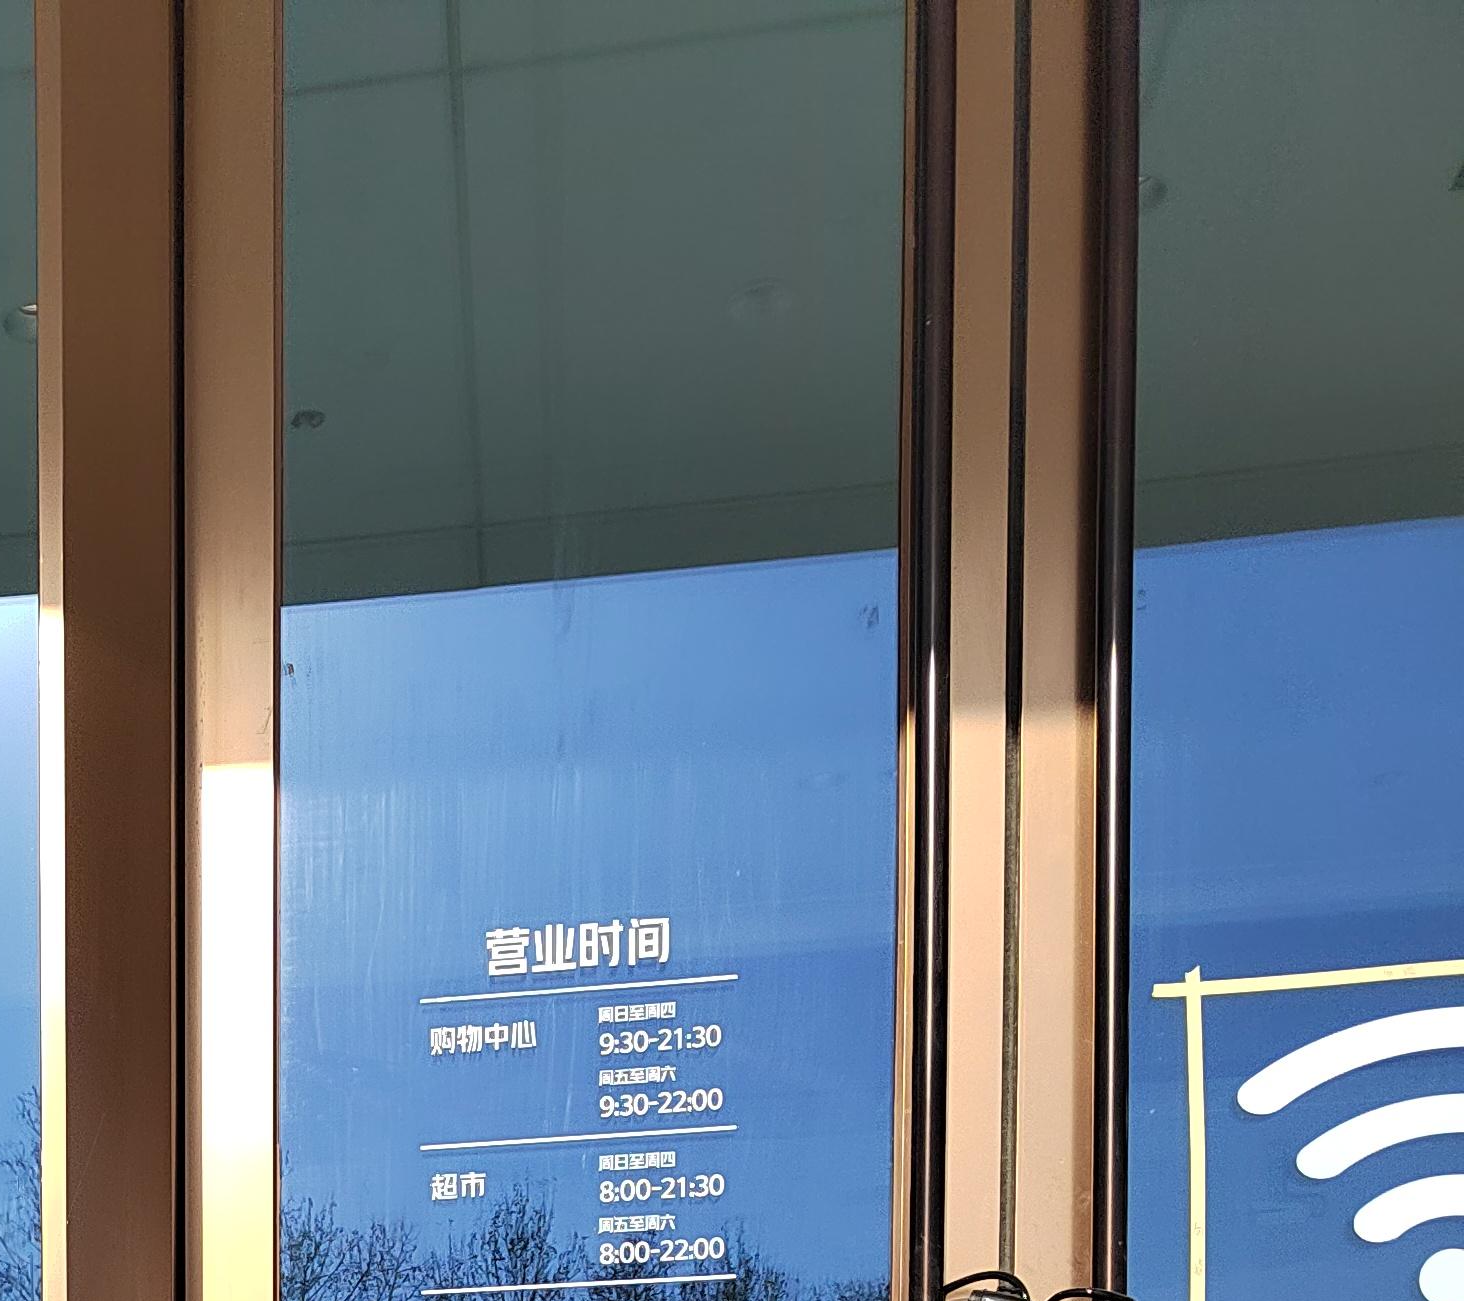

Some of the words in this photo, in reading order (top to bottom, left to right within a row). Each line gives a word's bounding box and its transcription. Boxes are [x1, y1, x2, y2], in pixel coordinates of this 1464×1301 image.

[486, 917, 670, 976] 营业时间
[598, 1001, 677, 1024] 周日至周四
[430, 1020, 537, 1055] 购物中心
[599, 1024, 722, 1055] 9:30-21:30
[598, 1065, 677, 1087] 周五至周六
[599, 1087, 723, 1118] 9:30-22:00
[598, 1151, 676, 1171] 周日至周四
[430, 1172, 486, 1201] 超市
[599, 1173, 725, 1203] 8:00-21:30
[598, 1214, 676, 1234] 周五至周六
[599, 1236, 725, 1265] 8:00-22:00
